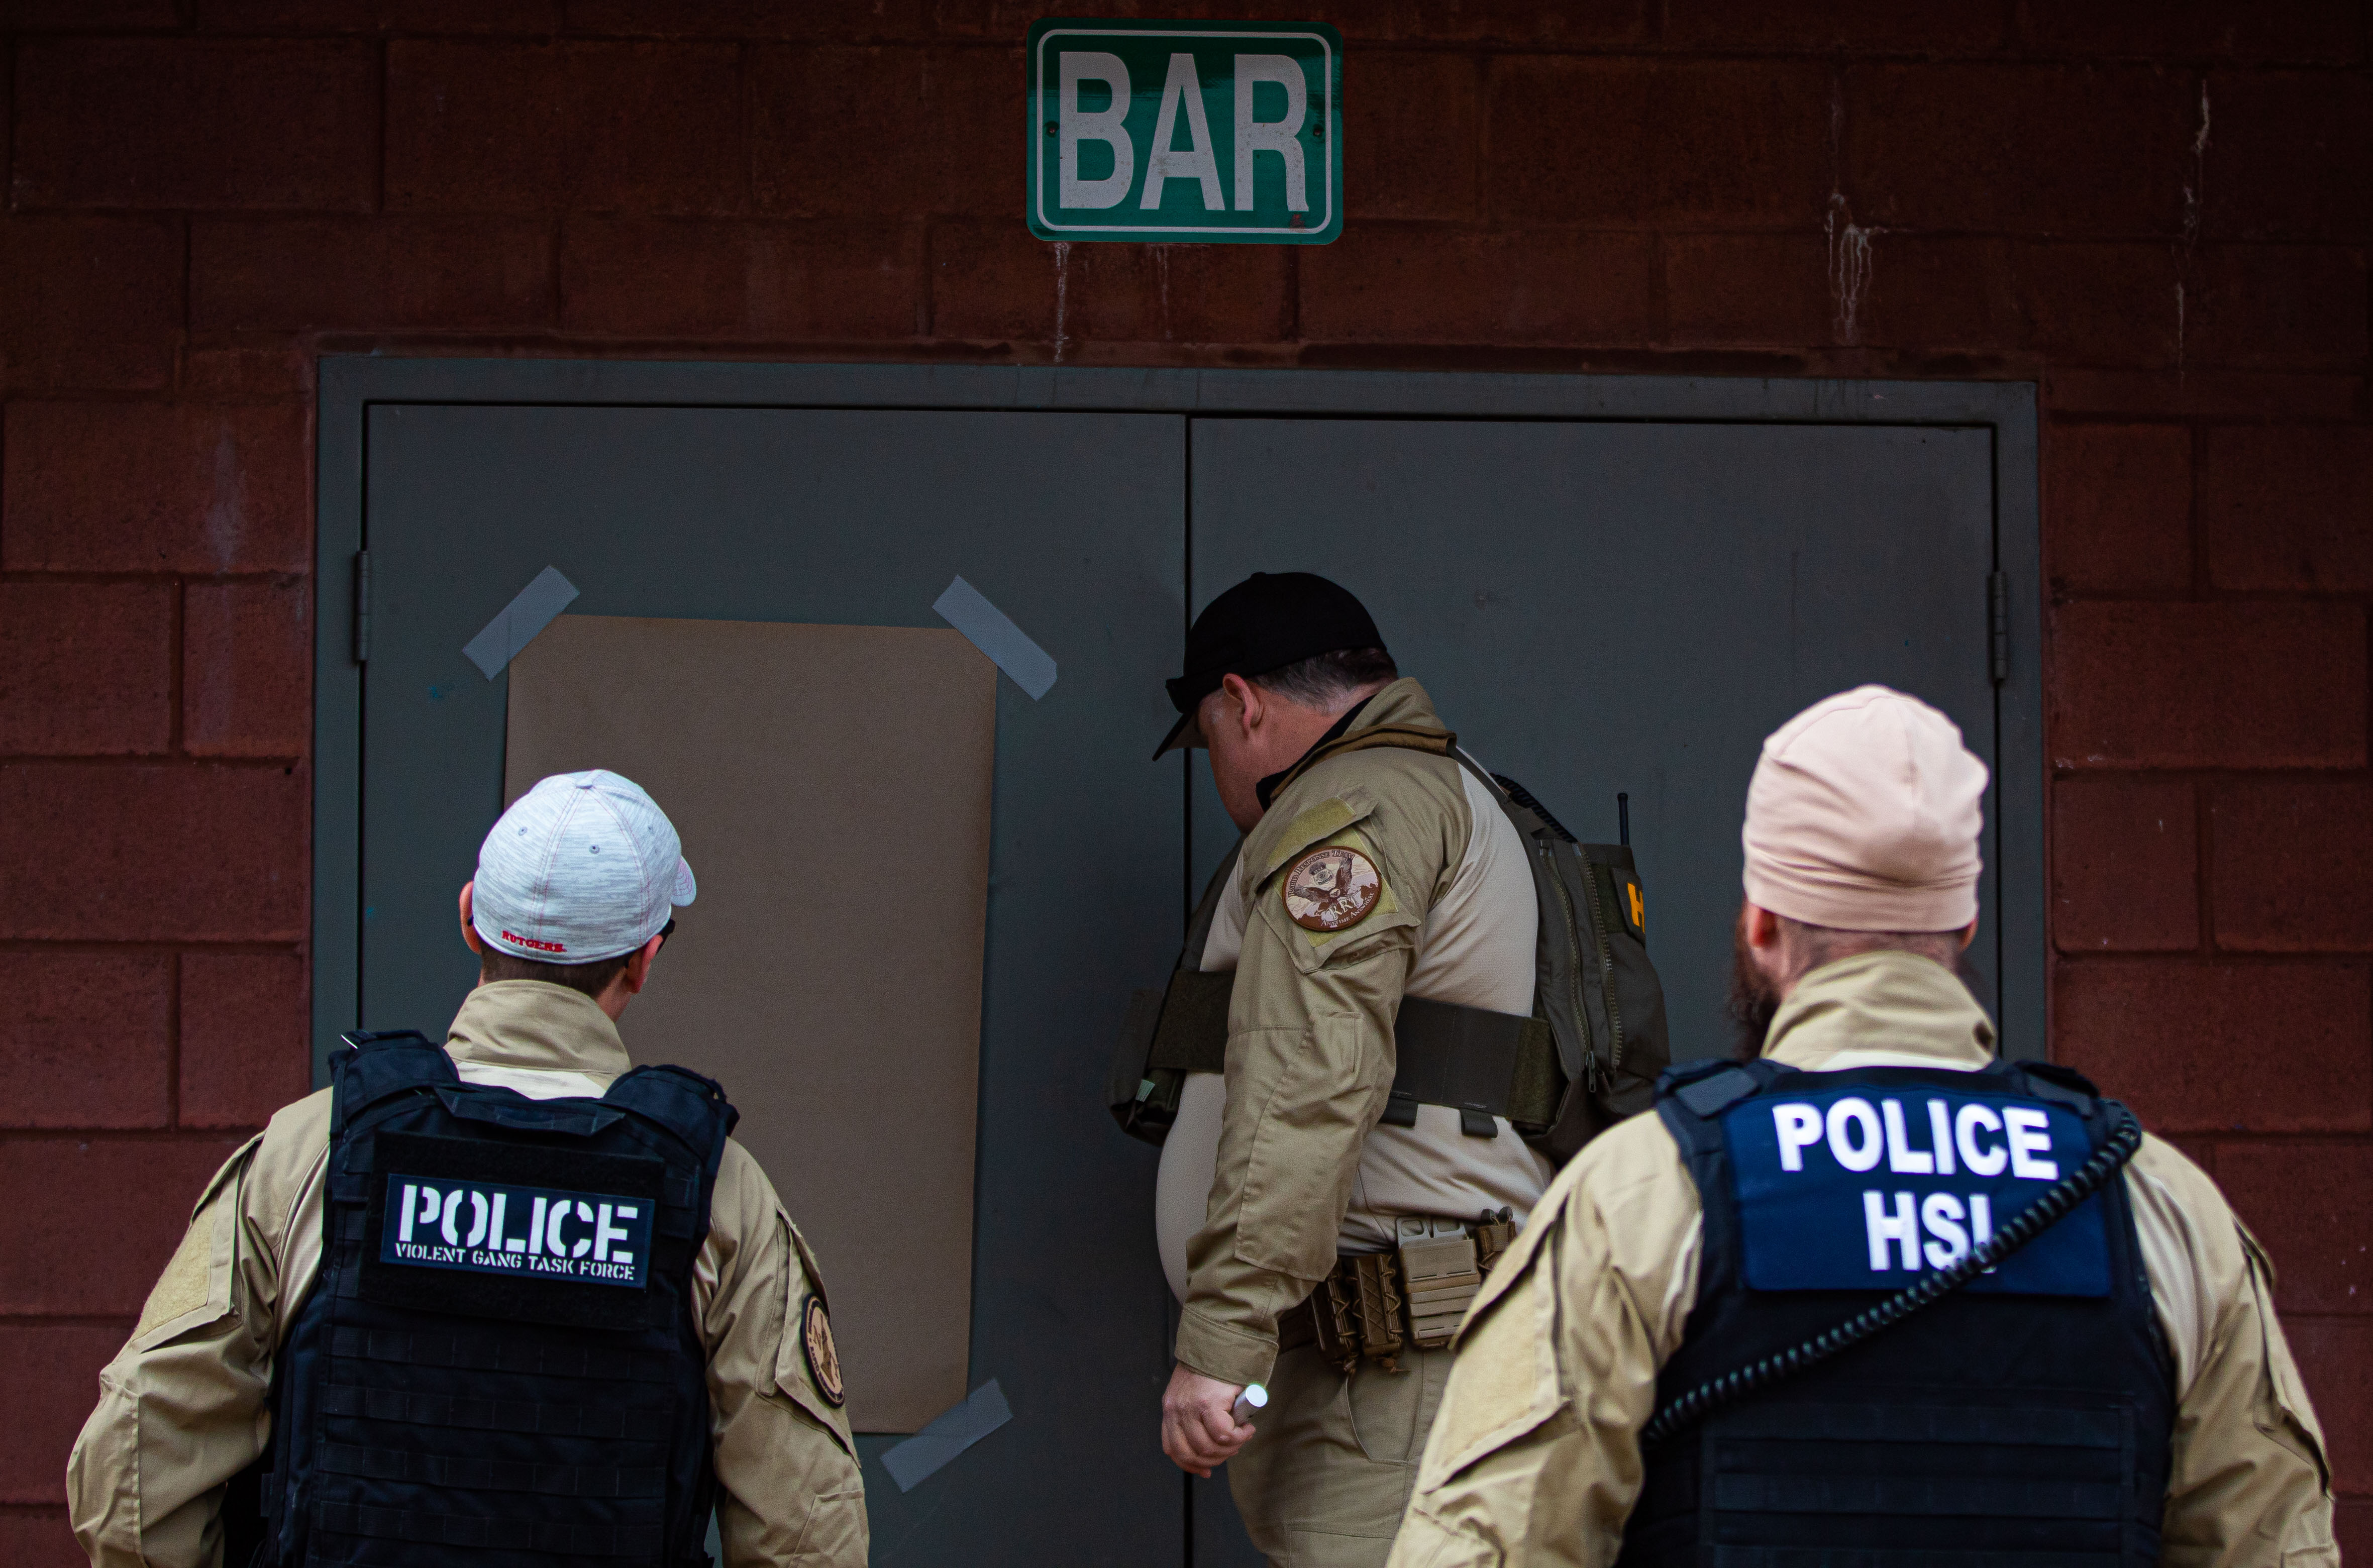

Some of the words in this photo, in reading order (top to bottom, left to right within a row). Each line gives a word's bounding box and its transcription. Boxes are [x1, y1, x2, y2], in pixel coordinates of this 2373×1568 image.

[1059, 51, 1309, 212] BAR
[1294, 852, 1330, 875] RESPONSE
[1331, 850, 1356, 861] TEAM
[1320, 916, 1350, 926] ANYTIME
[1351, 892, 1374, 918] ANYWHERE
[502, 930, 565, 952] RUTGERS
[1772, 1096, 2059, 1181] POLICE
[398, 1184, 638, 1264] POLICE
[1863, 1189, 1997, 1274] HSI
[394, 1242, 466, 1264] VIOLENT
[472, 1250, 522, 1269] GANG
[528, 1256, 574, 1275] TASK
[579, 1262, 635, 1281] FORCE
